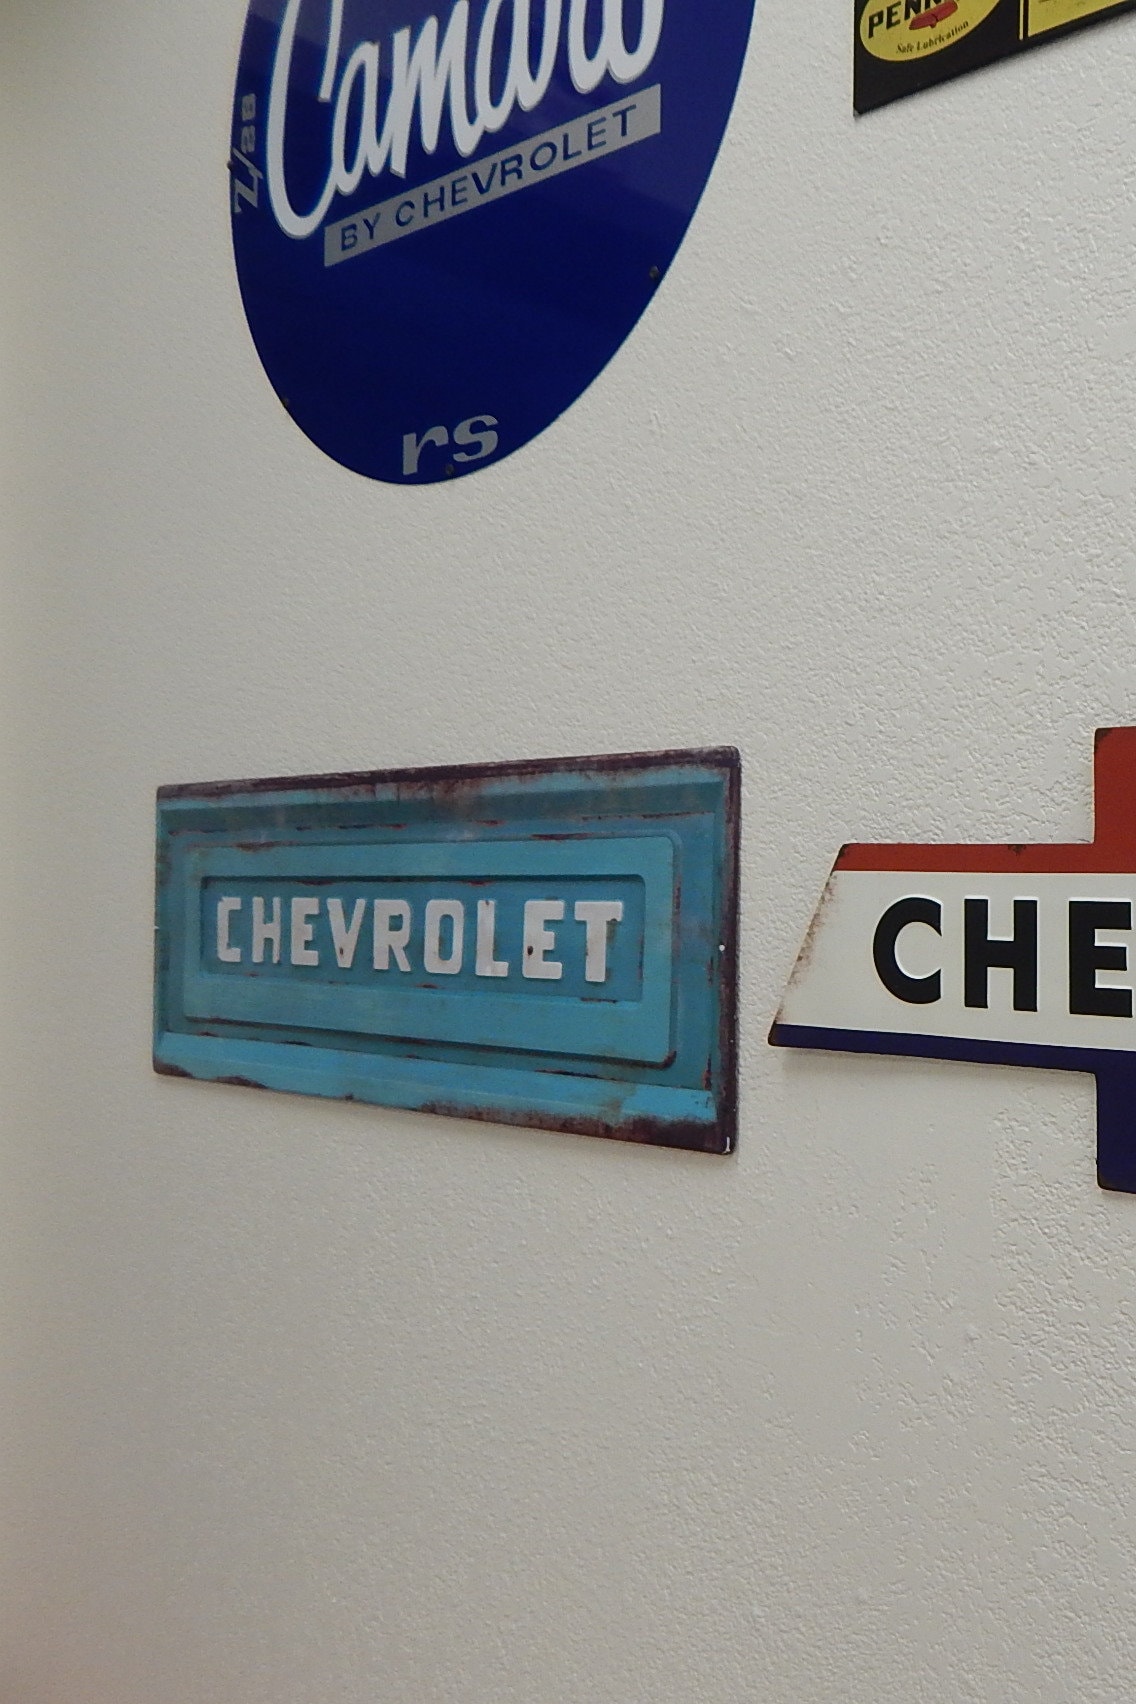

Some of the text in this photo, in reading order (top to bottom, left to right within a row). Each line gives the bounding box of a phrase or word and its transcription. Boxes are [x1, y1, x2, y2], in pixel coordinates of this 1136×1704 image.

[916, 20, 969, 52] Lubrication
[340, 105, 637, 252] BY CHEVROLET
[402, 414, 499, 475] rs
[216, 896, 623, 983] CHEVROLET
